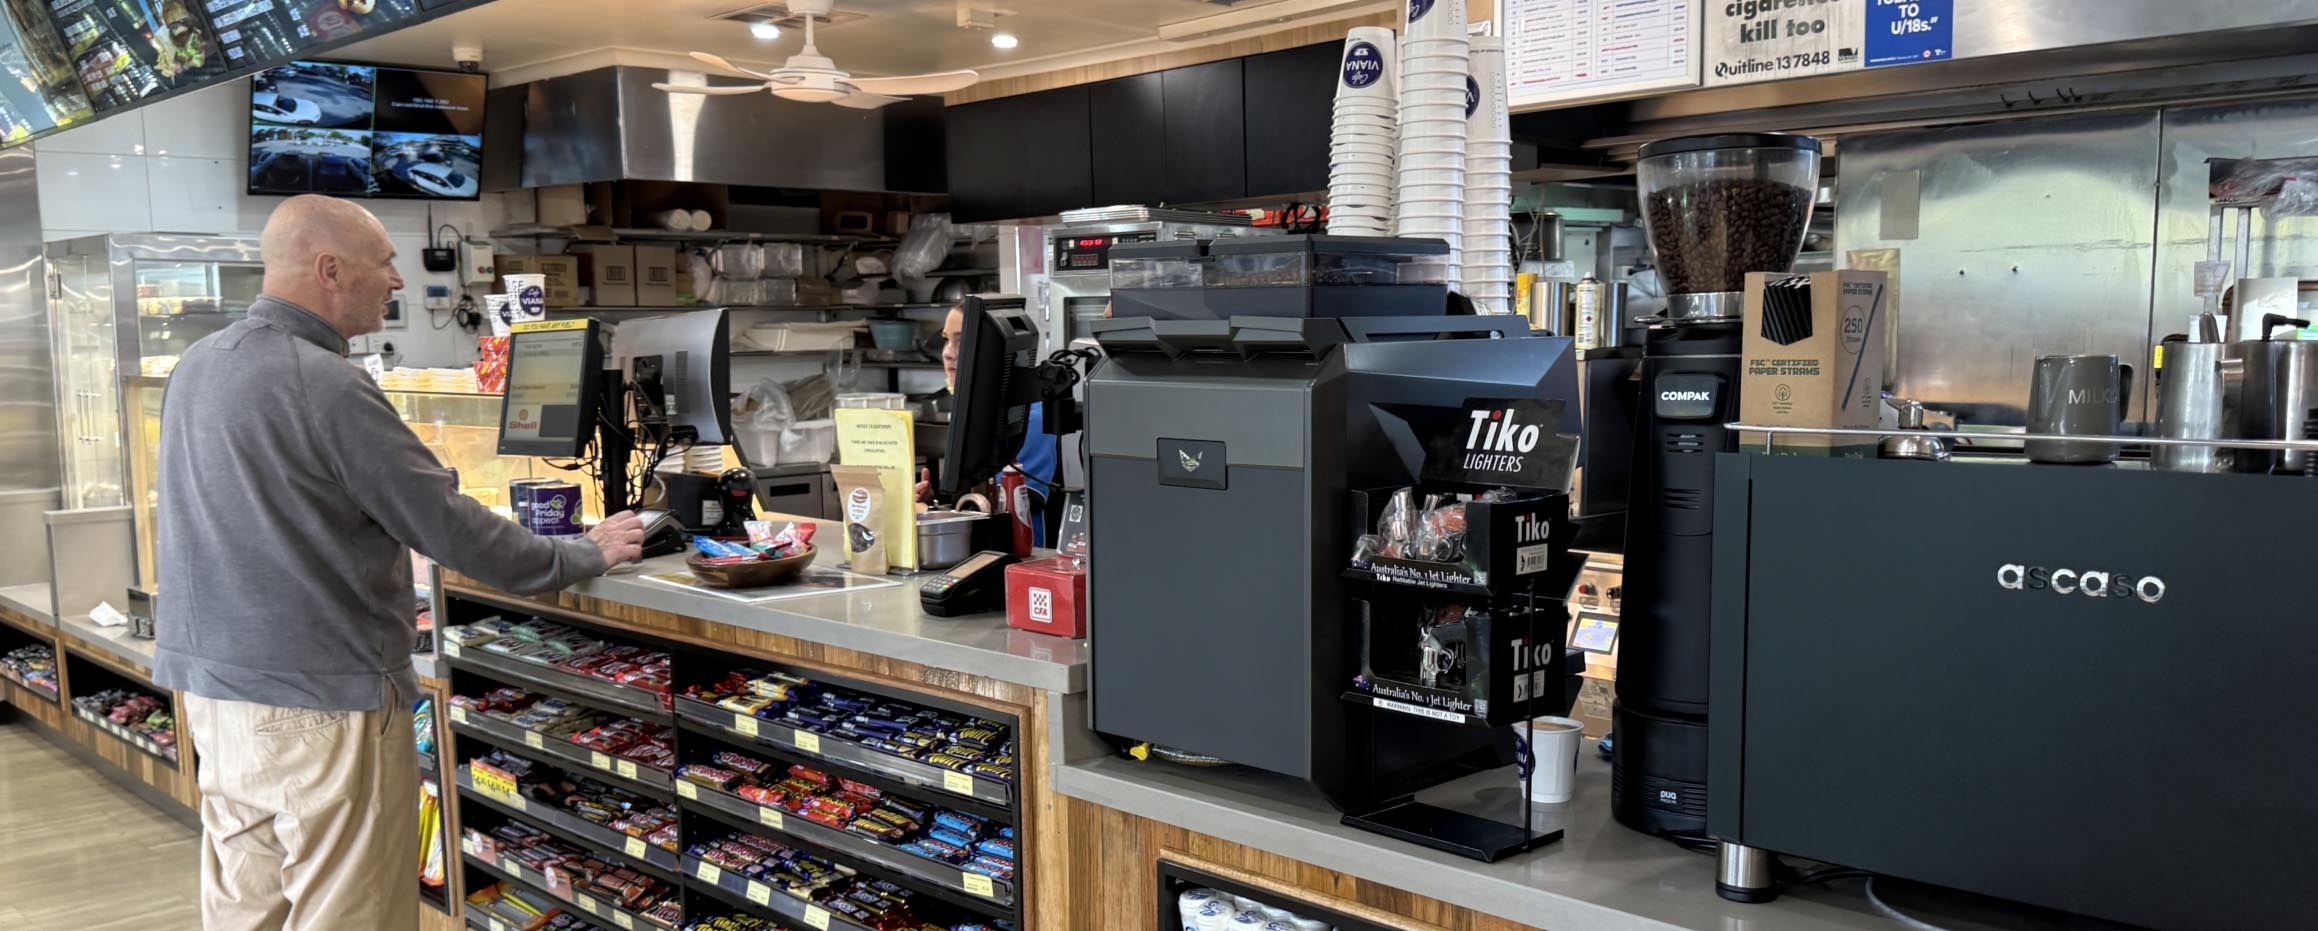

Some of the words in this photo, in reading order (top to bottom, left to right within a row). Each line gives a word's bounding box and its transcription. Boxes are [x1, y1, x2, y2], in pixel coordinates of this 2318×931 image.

[1725, 0, 1840, 20] cigare
[1898, 3, 1920, 18] TO
[1740, 18, 1778, 43] kill
[1786, 19, 1826, 37] too
[1345, 60, 1380, 72] VIANA
[1714, 58, 1774, 78] Quitline
[1844, 318, 1863, 333] 250
[1771, 359, 1819, 367] CERTIFIED
[1748, 367, 1778, 376] PAPER
[1780, 367, 1820, 376] STRAWS
[1661, 391, 1710, 402] COMPAK
[509, 421, 537, 429] Shell
[1465, 409, 1540, 453] Tiko
[1463, 453, 1524, 473] LIGHTERS
[531, 500, 550, 511] good
[1515, 512, 1550, 543] Tiko
[1370, 562, 1409, 578] Australia's
[1409, 568, 1422, 578] No.
[1428, 569, 1440, 581] Jet
[1441, 571, 1472, 584] Lighter
[1997, 563, 2166, 604] ascaso
[1034, 606, 1048, 617] CFA
[1372, 683, 1410, 700] Australia's
[1411, 690, 1425, 703] No.
[1430, 694, 1441, 707] Jet
[1442, 696, 1473, 711] Lighter
[1413, 706, 1425, 715] THIS
